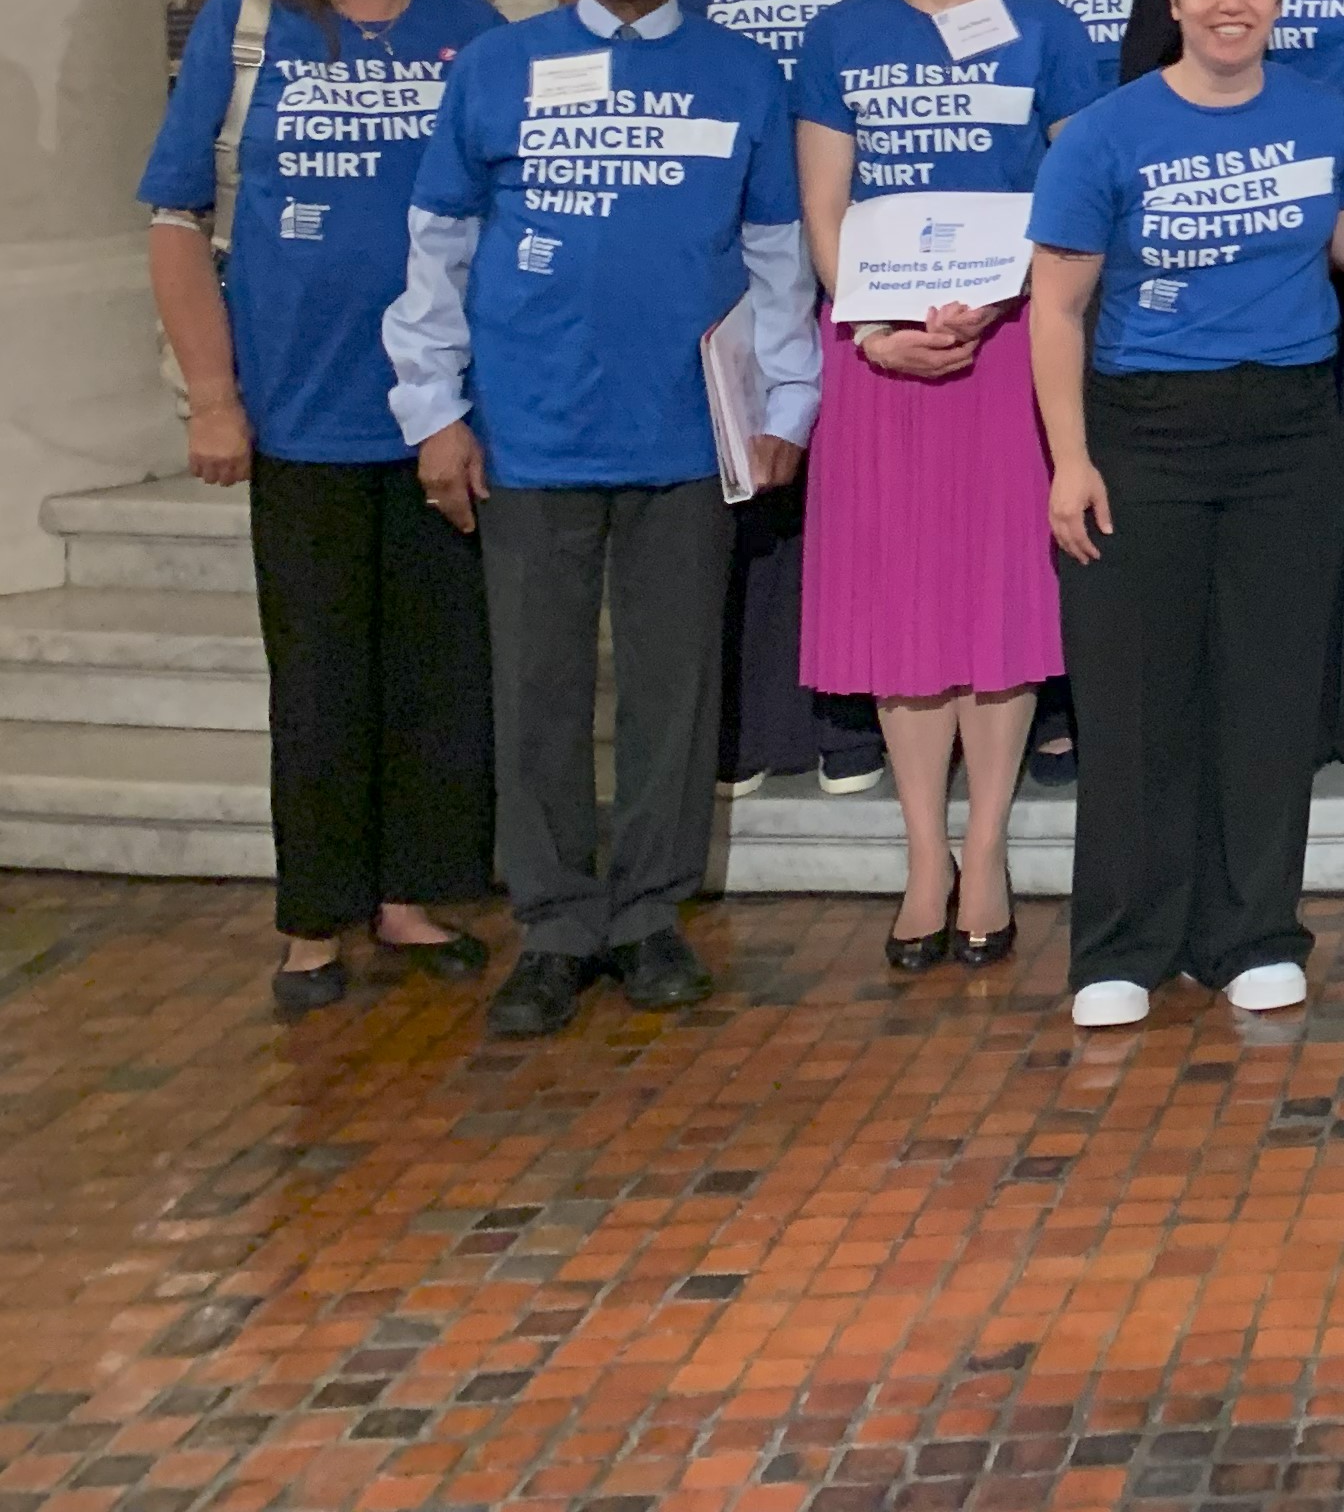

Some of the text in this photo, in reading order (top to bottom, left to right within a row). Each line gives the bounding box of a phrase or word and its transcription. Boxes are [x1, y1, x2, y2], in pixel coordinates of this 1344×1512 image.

[710, 3, 828, 26] CANCE
[275, 58, 443, 82] THIS IS MY
[839, 61, 999, 91] THIS IS MY
[283, 84, 421, 109] CANCER
[605, 89, 695, 117] IS MY
[276, 114, 438, 141] FIGHTING
[521, 125, 665, 152] CANCER
[277, 151, 382, 178] SHIRT
[521, 158, 686, 186] FIGHTING
[1139, 140, 1297, 187] THIS IS MY
[524, 188, 619, 218] SHIRT
[1144, 176, 1281, 209] CANCER
[1141, 204, 1304, 241] FIGHTING
[859, 255, 1016, 273] Patients & Families
[1141, 245, 1241, 270] SHIRT
[868, 273, 1002, 291] Need Paid Leave
